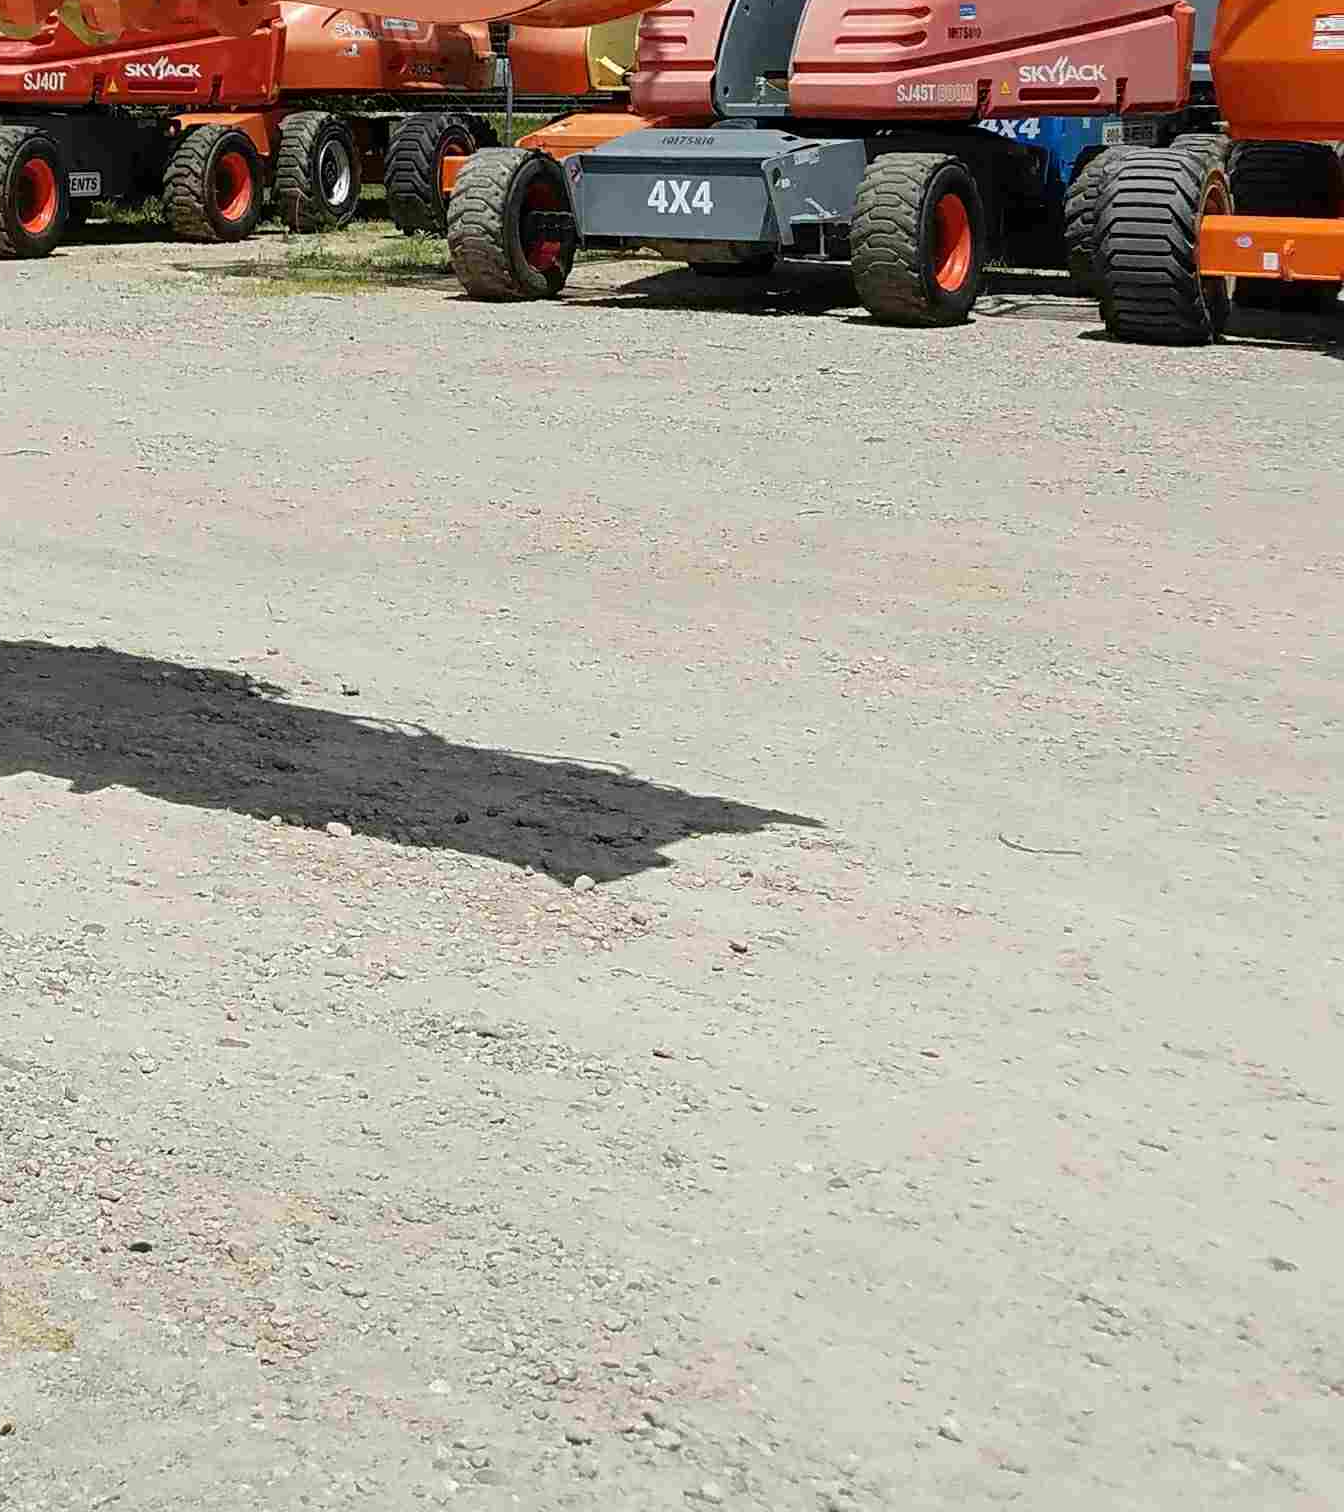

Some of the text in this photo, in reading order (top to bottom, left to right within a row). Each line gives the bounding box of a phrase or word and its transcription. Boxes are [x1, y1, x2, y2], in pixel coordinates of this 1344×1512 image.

[124, 55, 202, 79] SKYJACK
[1018, 55, 1108, 85] SKYJACK
[23, 71, 69, 92] SJ40T
[896, 84, 937, 103] SJ45T
[647, 179, 714, 215] 4X4
